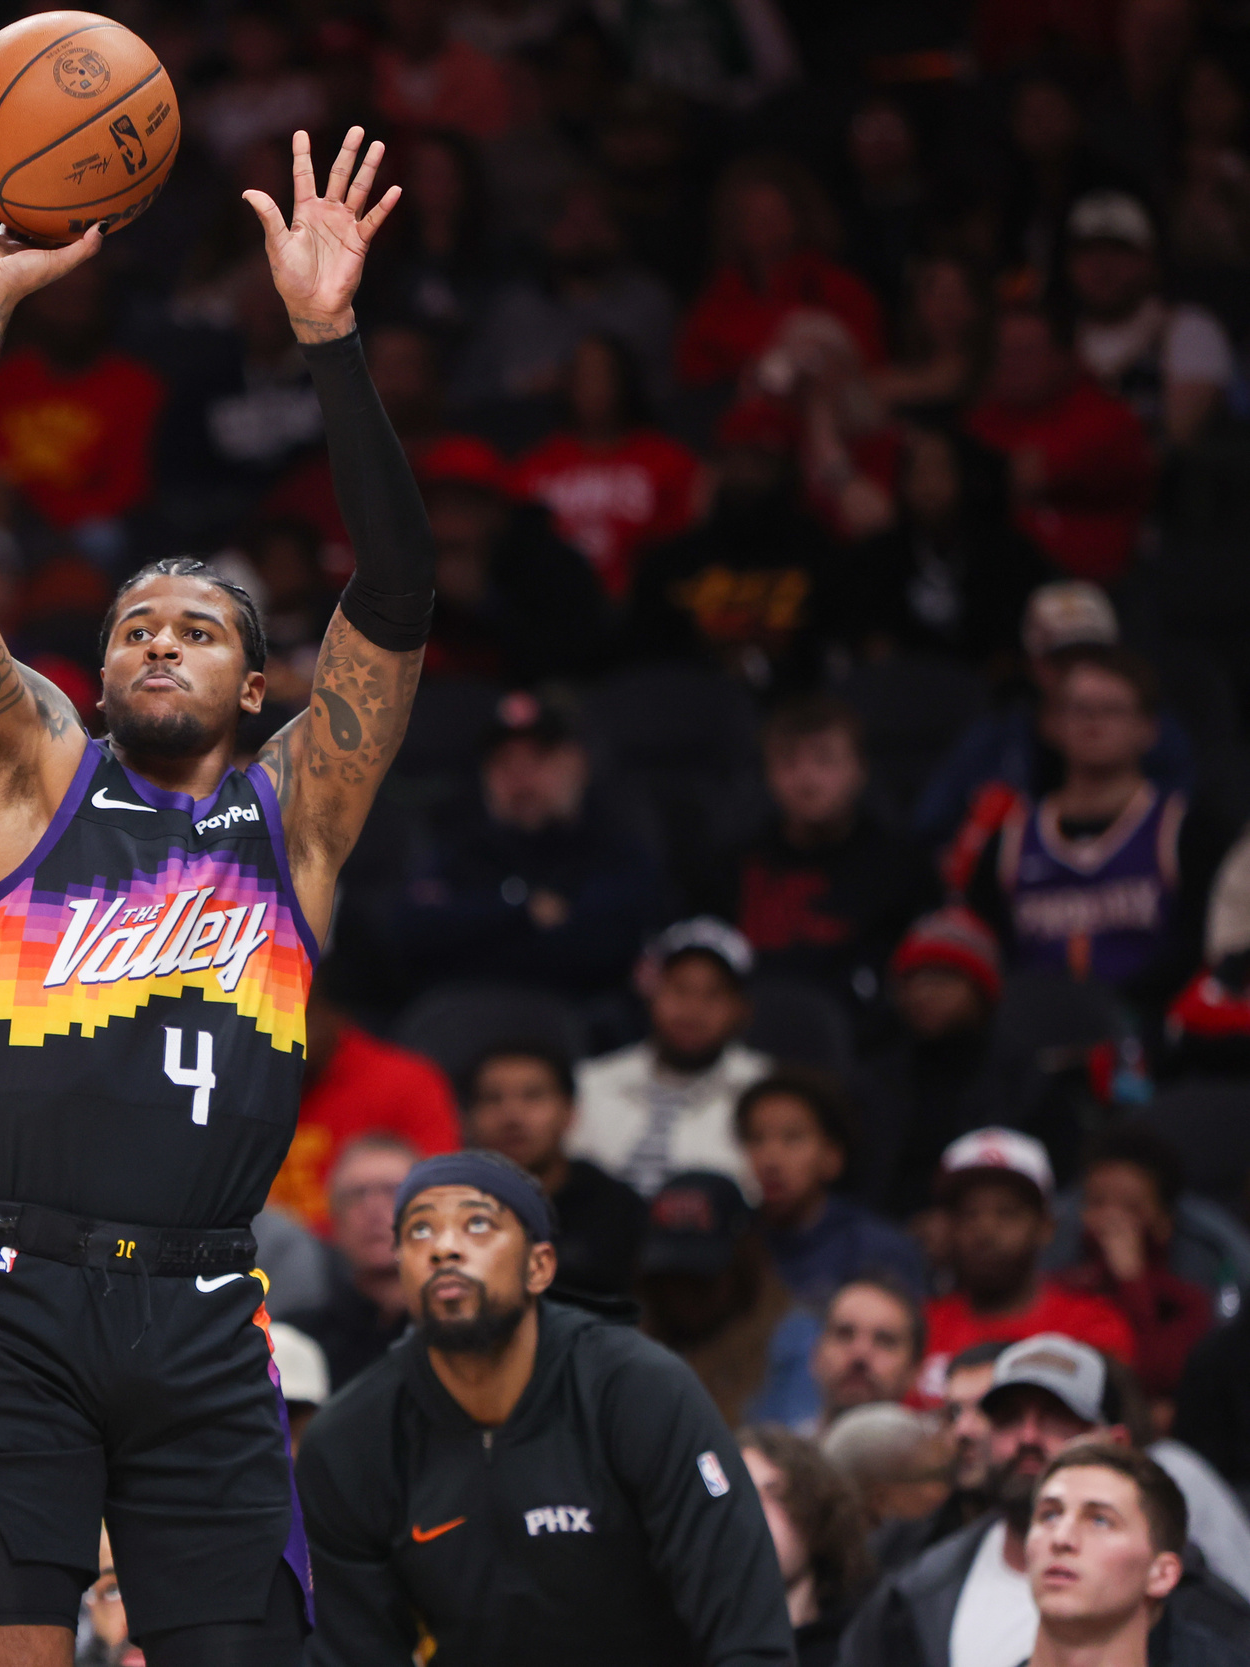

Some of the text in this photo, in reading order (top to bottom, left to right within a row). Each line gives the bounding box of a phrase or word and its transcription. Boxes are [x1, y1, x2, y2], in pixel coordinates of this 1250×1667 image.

[194, 804, 260, 836] PayPal
[121, 903, 167, 926] THE
[43, 886, 269, 994] Valley
[162, 1025, 217, 1126] 4
[523, 1504, 594, 1537] PHX
